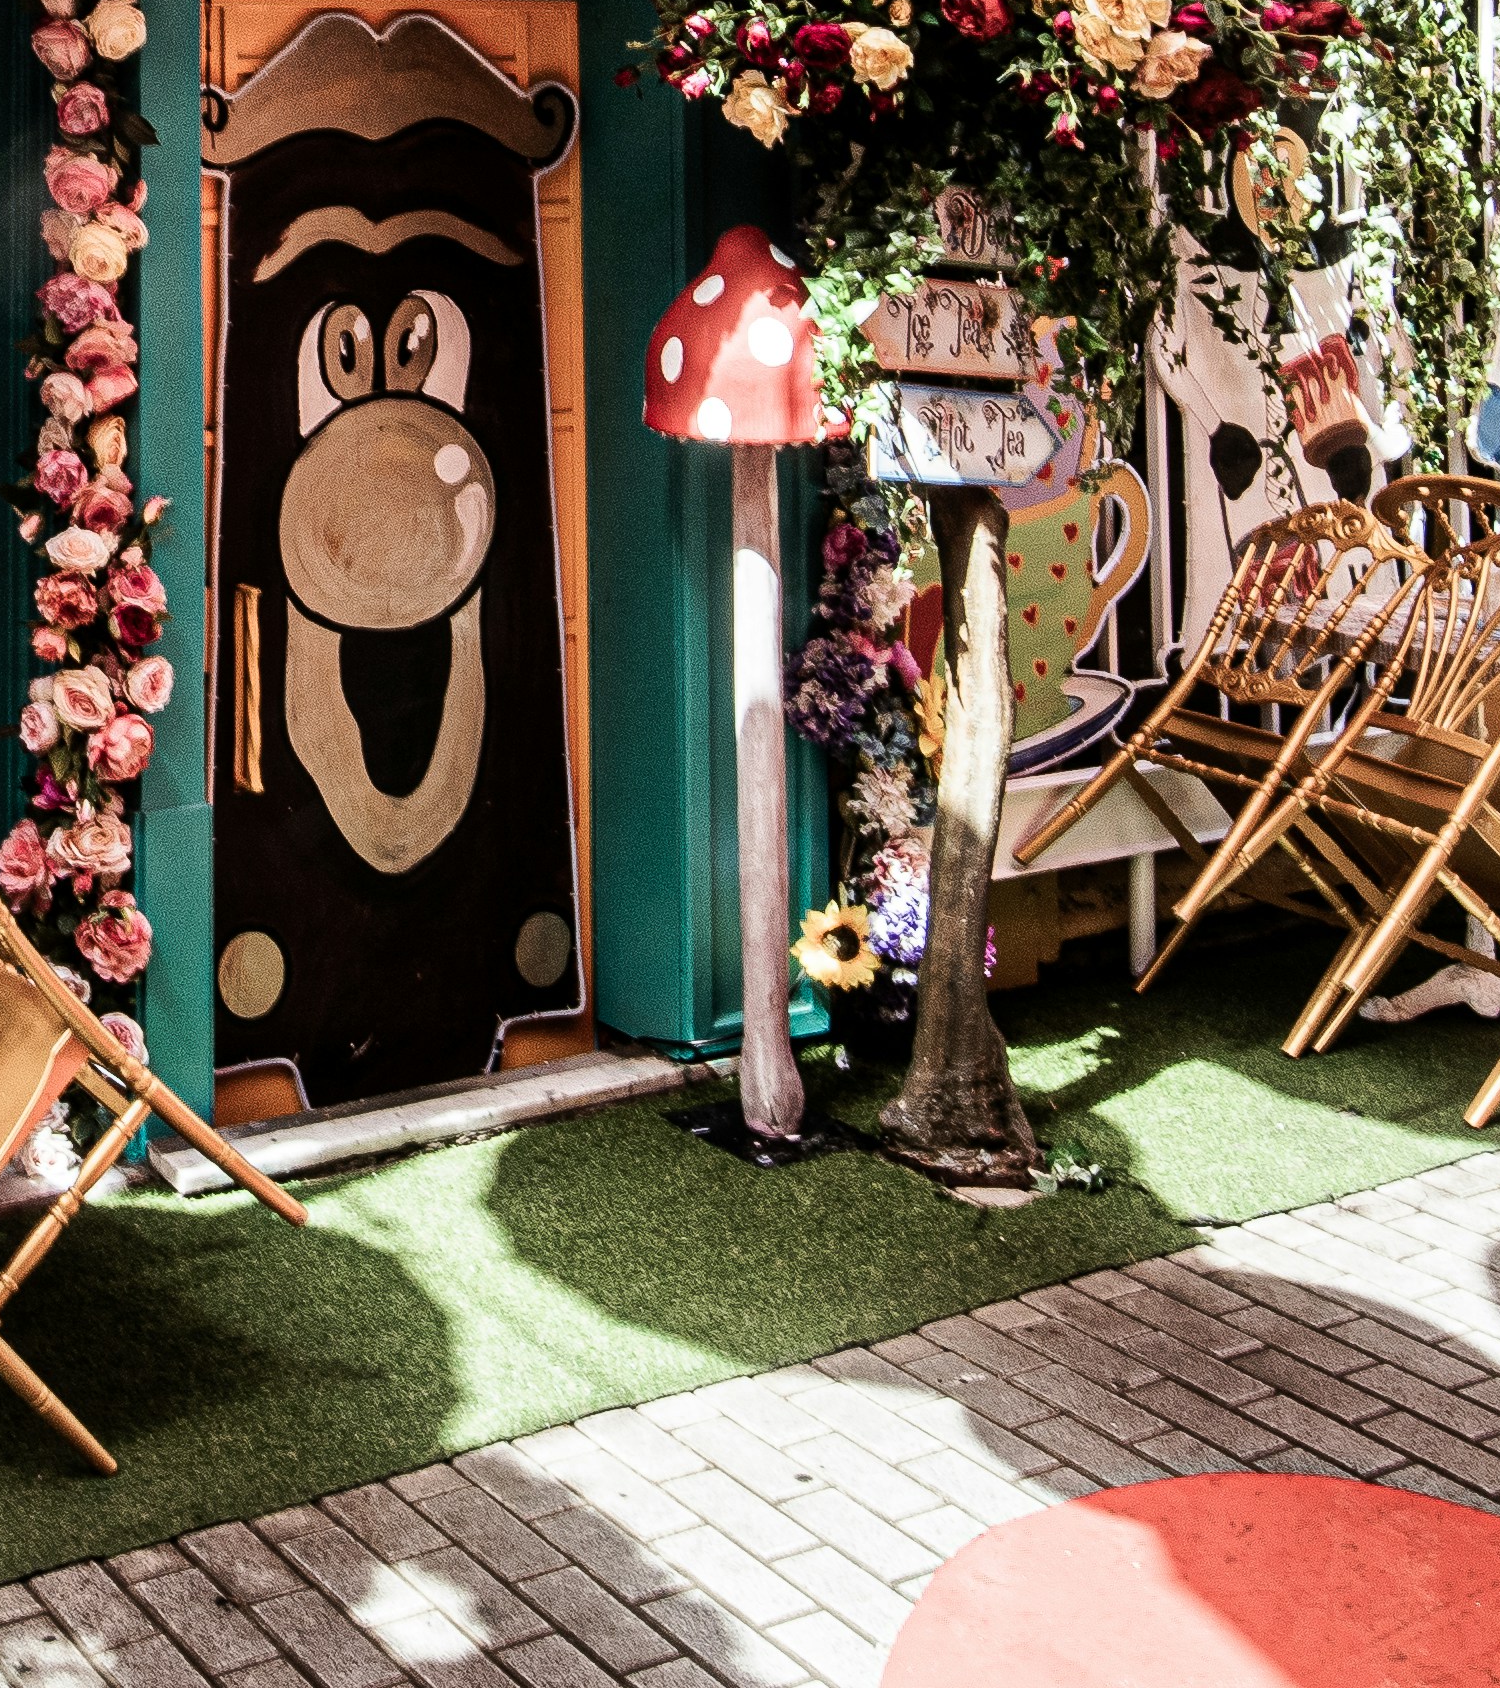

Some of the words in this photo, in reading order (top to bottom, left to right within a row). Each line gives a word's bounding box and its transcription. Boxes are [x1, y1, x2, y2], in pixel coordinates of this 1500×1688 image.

[940, 288, 984, 358] Tea
[918, 402, 975, 470] Hot
[983, 400, 1026, 472] Tea
